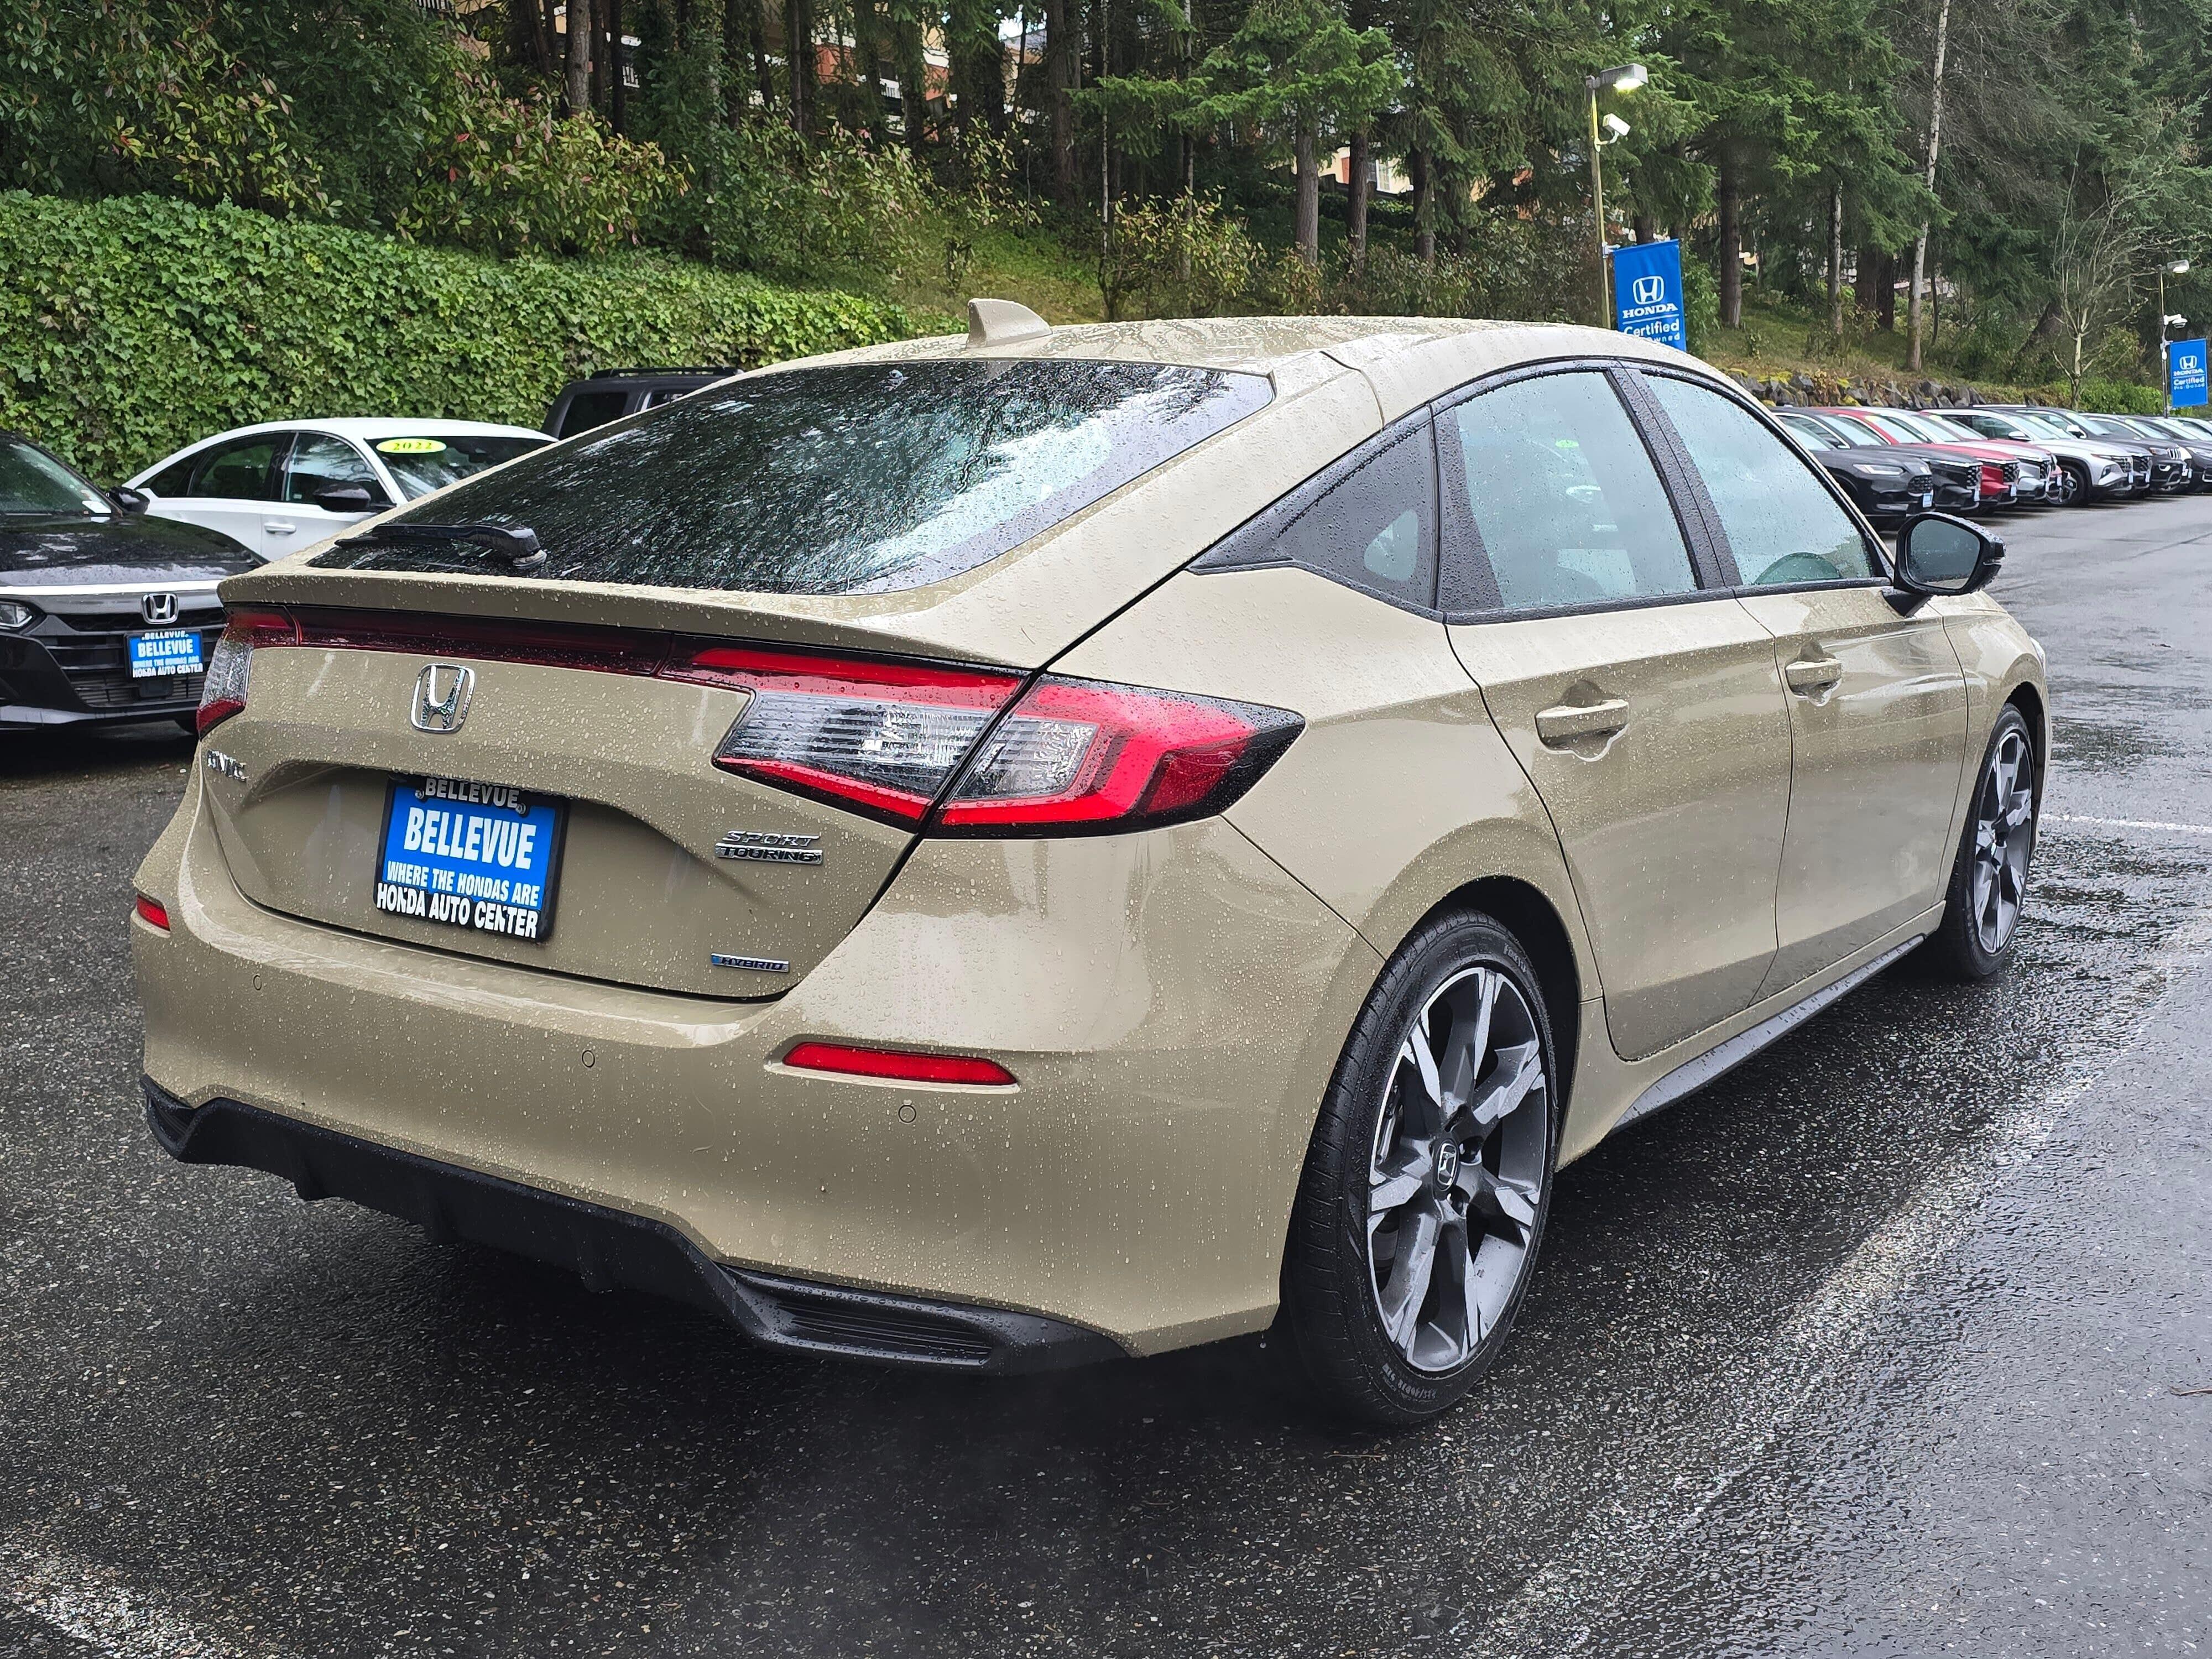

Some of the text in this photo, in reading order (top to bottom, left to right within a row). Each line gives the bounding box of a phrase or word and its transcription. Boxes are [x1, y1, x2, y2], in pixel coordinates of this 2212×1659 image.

[1623, 303, 1678, 319] HONDA
[1624, 318, 1679, 337] Certified
[2174, 376, 2205, 385] Certified
[393, 442, 432, 451] 2022
[144, 630, 186, 640] BELLEVUE
[137, 639, 194, 658] BELLEVUE
[157, 665, 176, 676] AUTO
[425, 778, 520, 808] BELLEVUE
[403, 806, 537, 870] BELLEVUE
[722, 830, 820, 847] SPORT
[717, 844, 822, 863] TOURING
[387, 860, 540, 907] WHERE THE HONDAS ARE
[376, 882, 539, 938] HONDA AUTO CENTER
[719, 954, 785, 971] HYBRID
